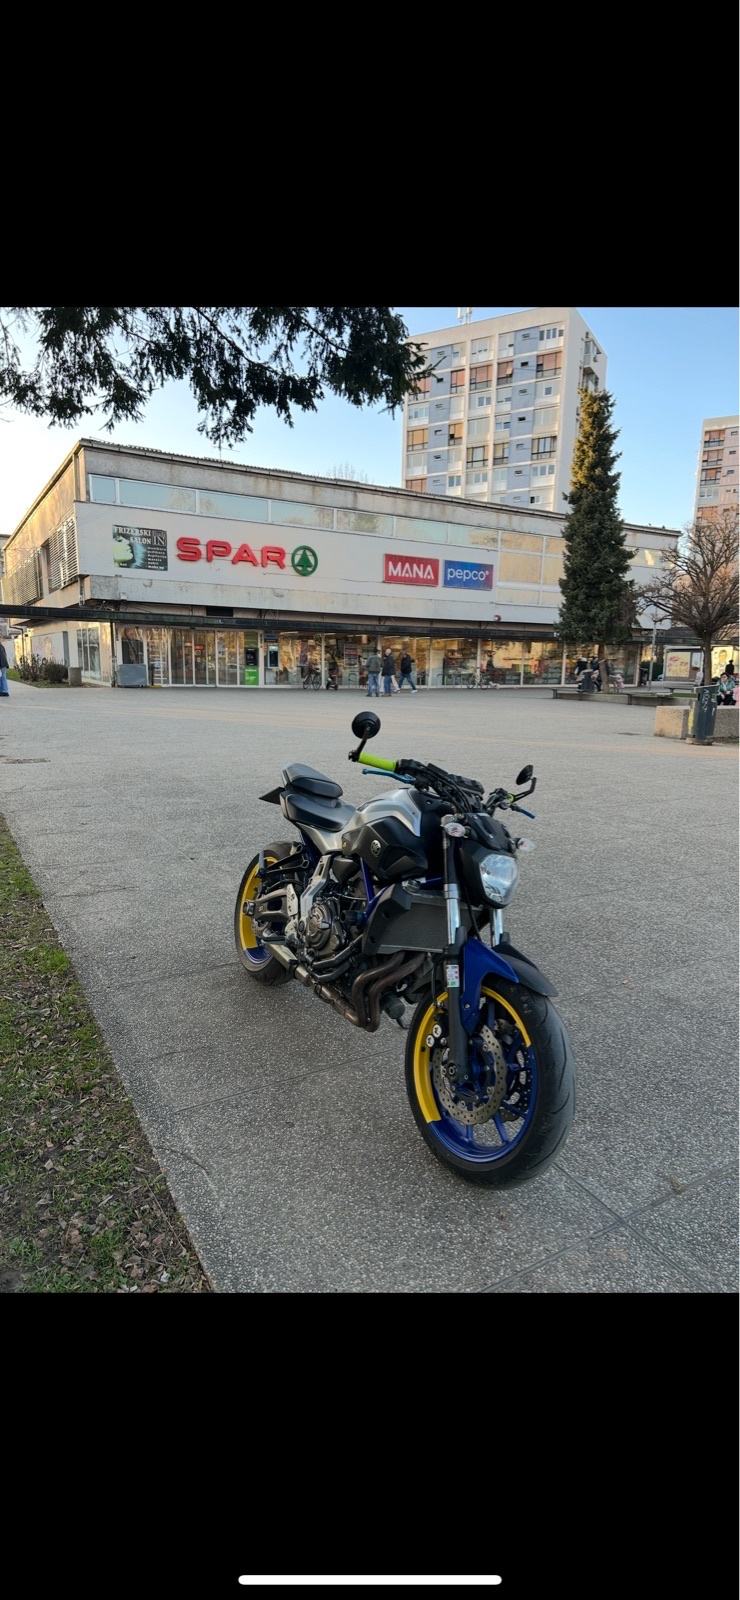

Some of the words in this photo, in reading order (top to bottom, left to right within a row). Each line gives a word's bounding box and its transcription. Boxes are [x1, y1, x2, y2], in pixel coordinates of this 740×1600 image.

[176, 537, 286, 569] SPAR
[388, 561, 434, 580] MANA
[447, 568, 486, 581] pepco
